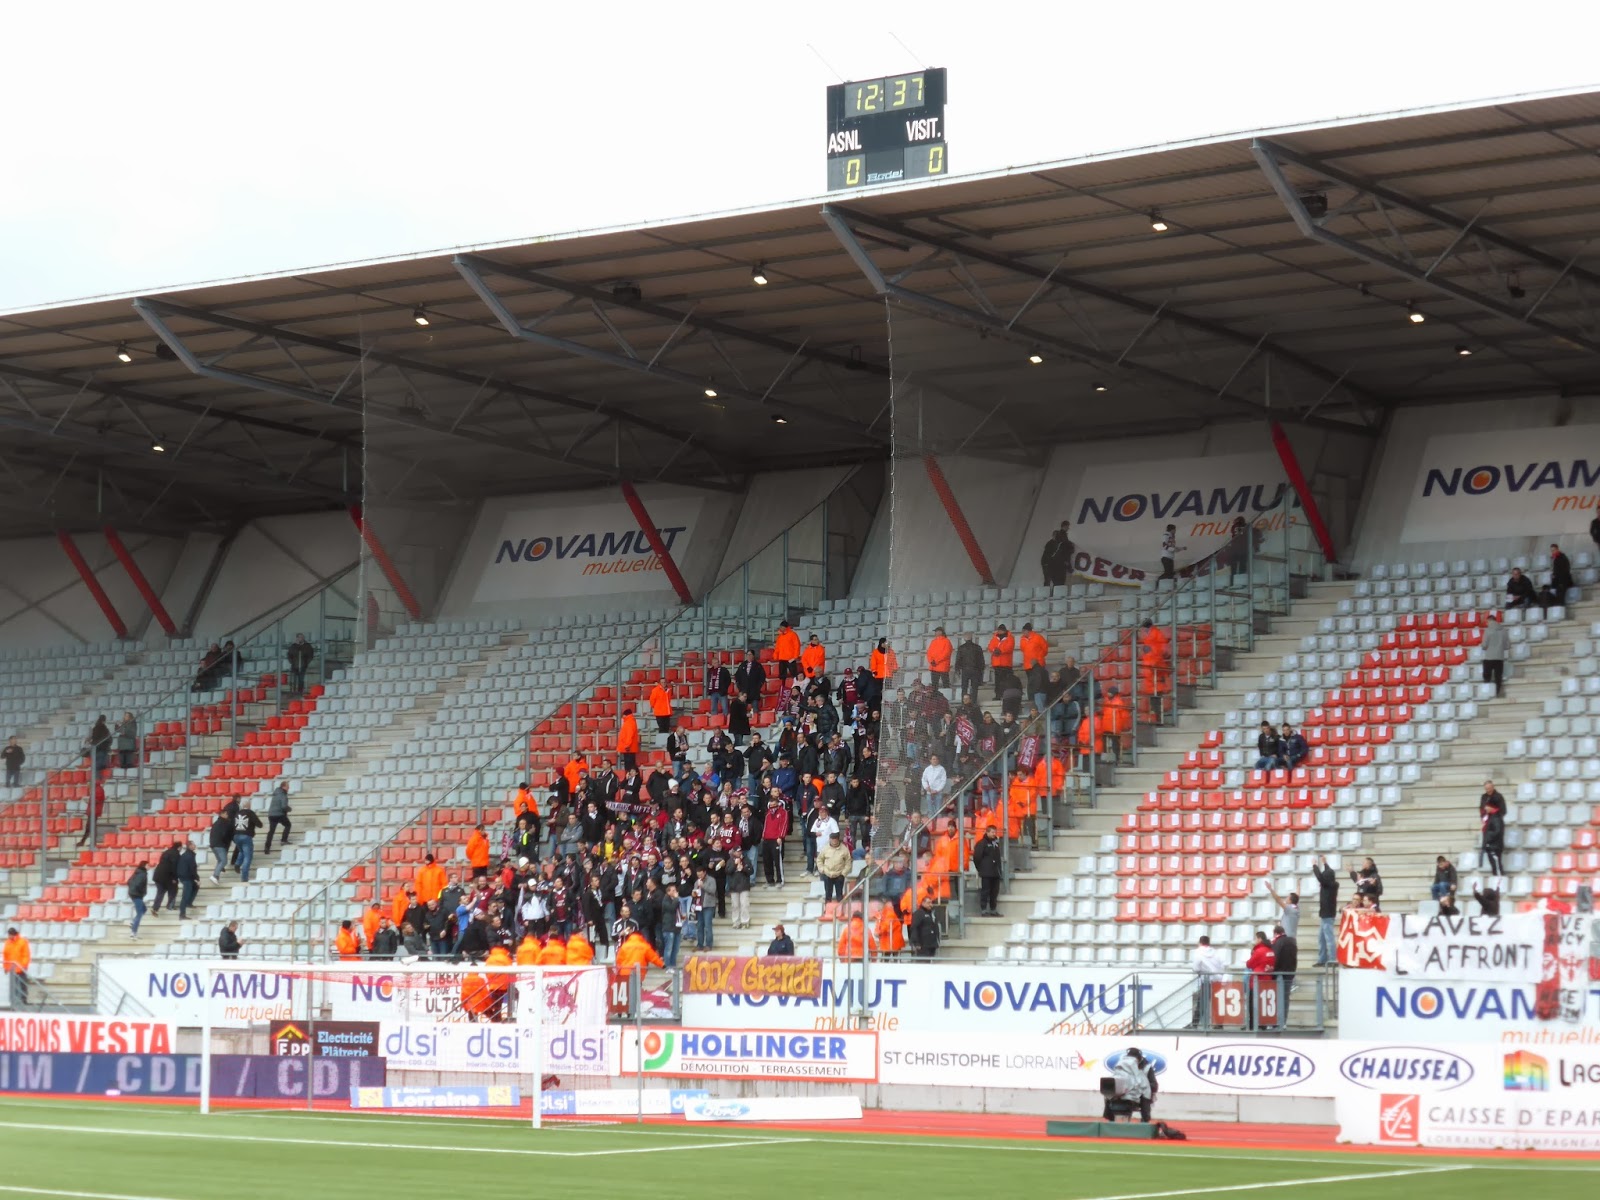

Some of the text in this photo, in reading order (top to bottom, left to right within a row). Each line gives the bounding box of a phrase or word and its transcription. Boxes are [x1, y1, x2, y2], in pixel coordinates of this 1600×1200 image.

[828, 117, 941, 154] ASNL VISIT.
[846, 158, 860, 185] 0
[928, 146, 943, 173] 0
[495, 526, 687, 564] NOVAMUT
[1401, 914, 1504, 939] LAVEZ
[426, 997, 464, 1013] ULTR
[612, 981, 628, 1007] 14
[944, 980, 1154, 1015] NOVAMUT
[1214, 988, 1241, 1017] 13
[1260, 988, 1276, 1018] 13
[814, 1012, 899, 1031] muuelle
[67, 1020, 170, 1054] VESTA
[386, 1025, 437, 1056] dlsi
[467, 1028, 519, 1058] dlsi
[550, 1029, 604, 1061] dlsi
[681, 1033, 847, 1060] HOLLINGER
[680, 1061, 848, 1077] DÉMOLITION TERRASSEMENT
[884, 1051, 1078, 1071] ST CHRISTOPHE LORRAINE
[1196, 1054, 1302, 1078] CHAUSSEA
[1349, 1057, 1460, 1081] CHAUSSEA
[1428, 1107, 1506, 1126] CAISSE
